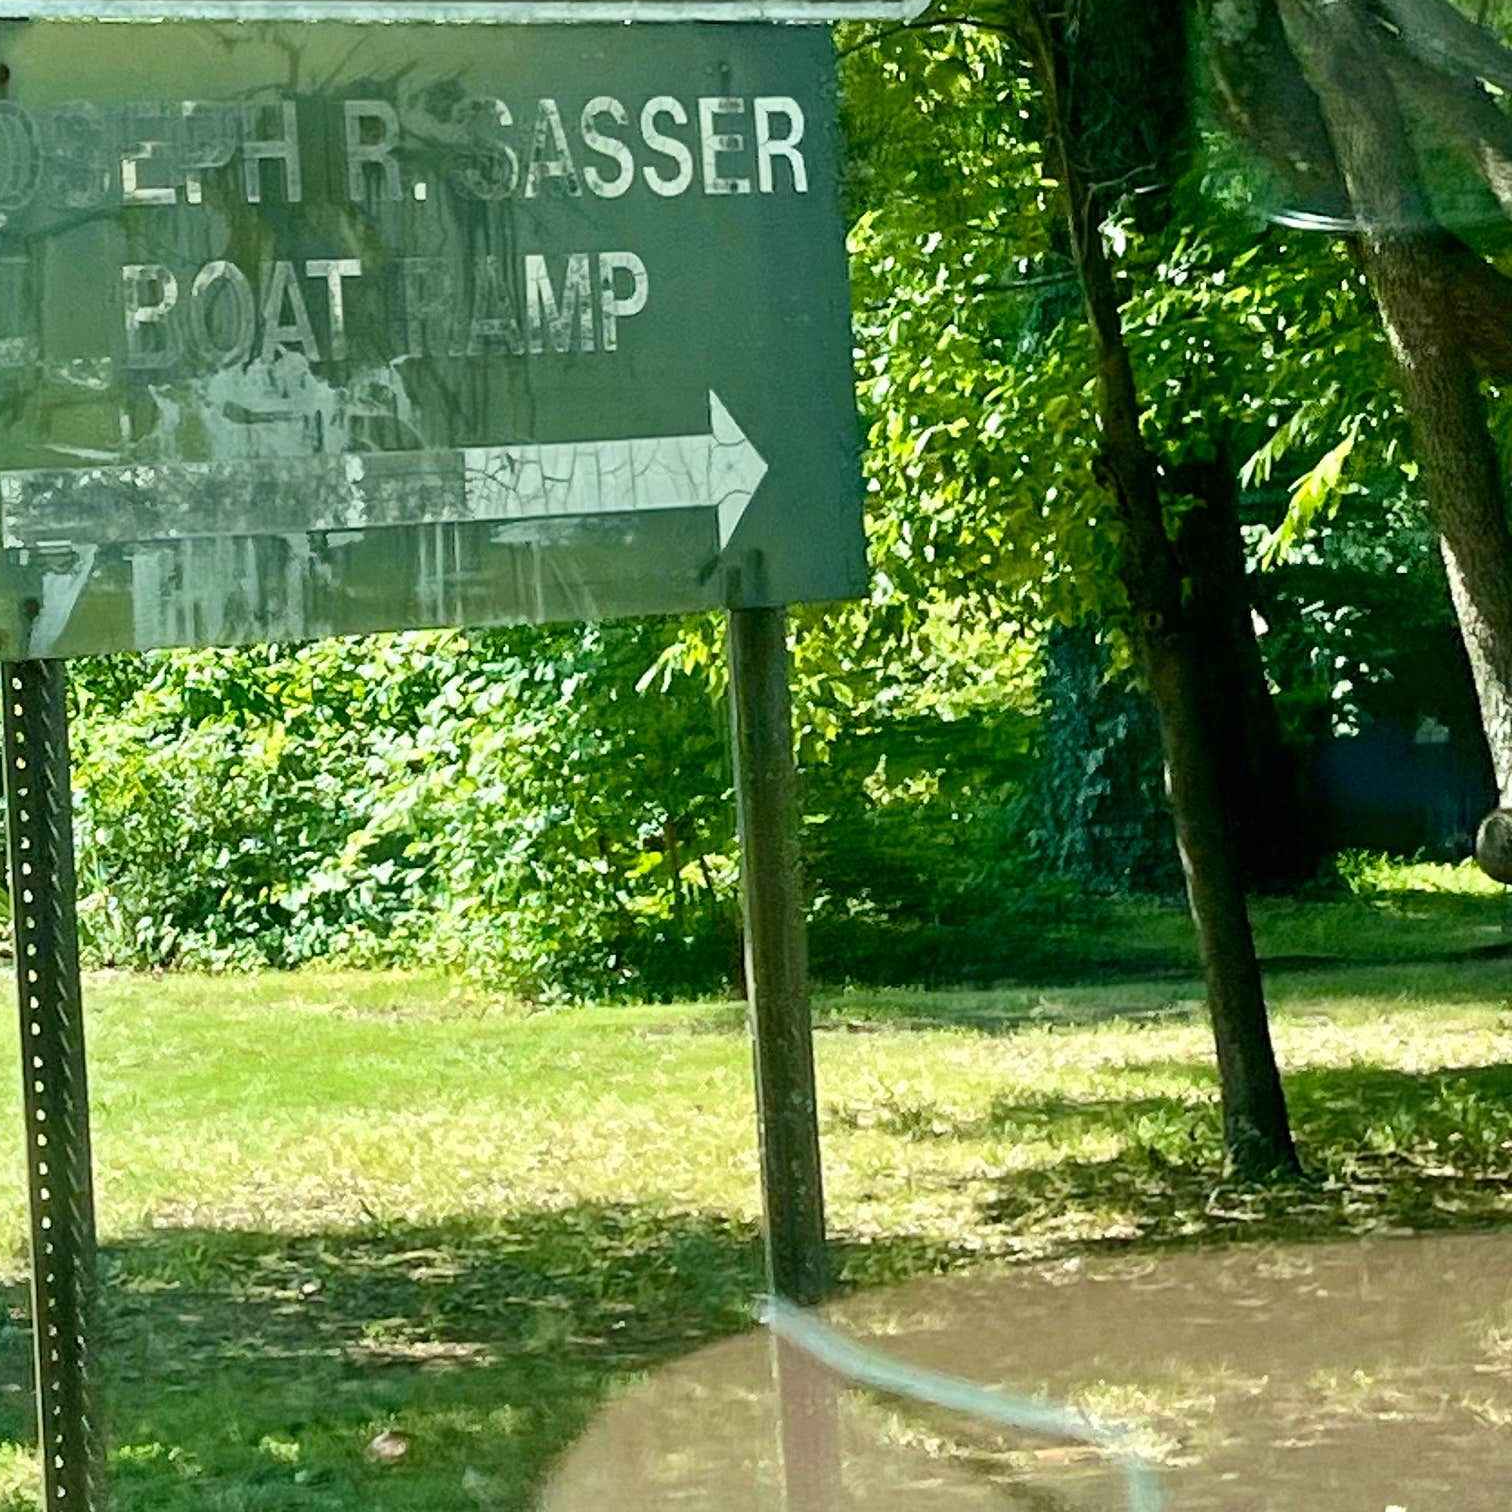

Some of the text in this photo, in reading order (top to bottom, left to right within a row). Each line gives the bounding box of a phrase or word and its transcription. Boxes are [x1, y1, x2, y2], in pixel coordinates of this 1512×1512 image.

[441, 94, 810, 199] SASSER
[120, 251, 649, 370] BOAT RAMP
